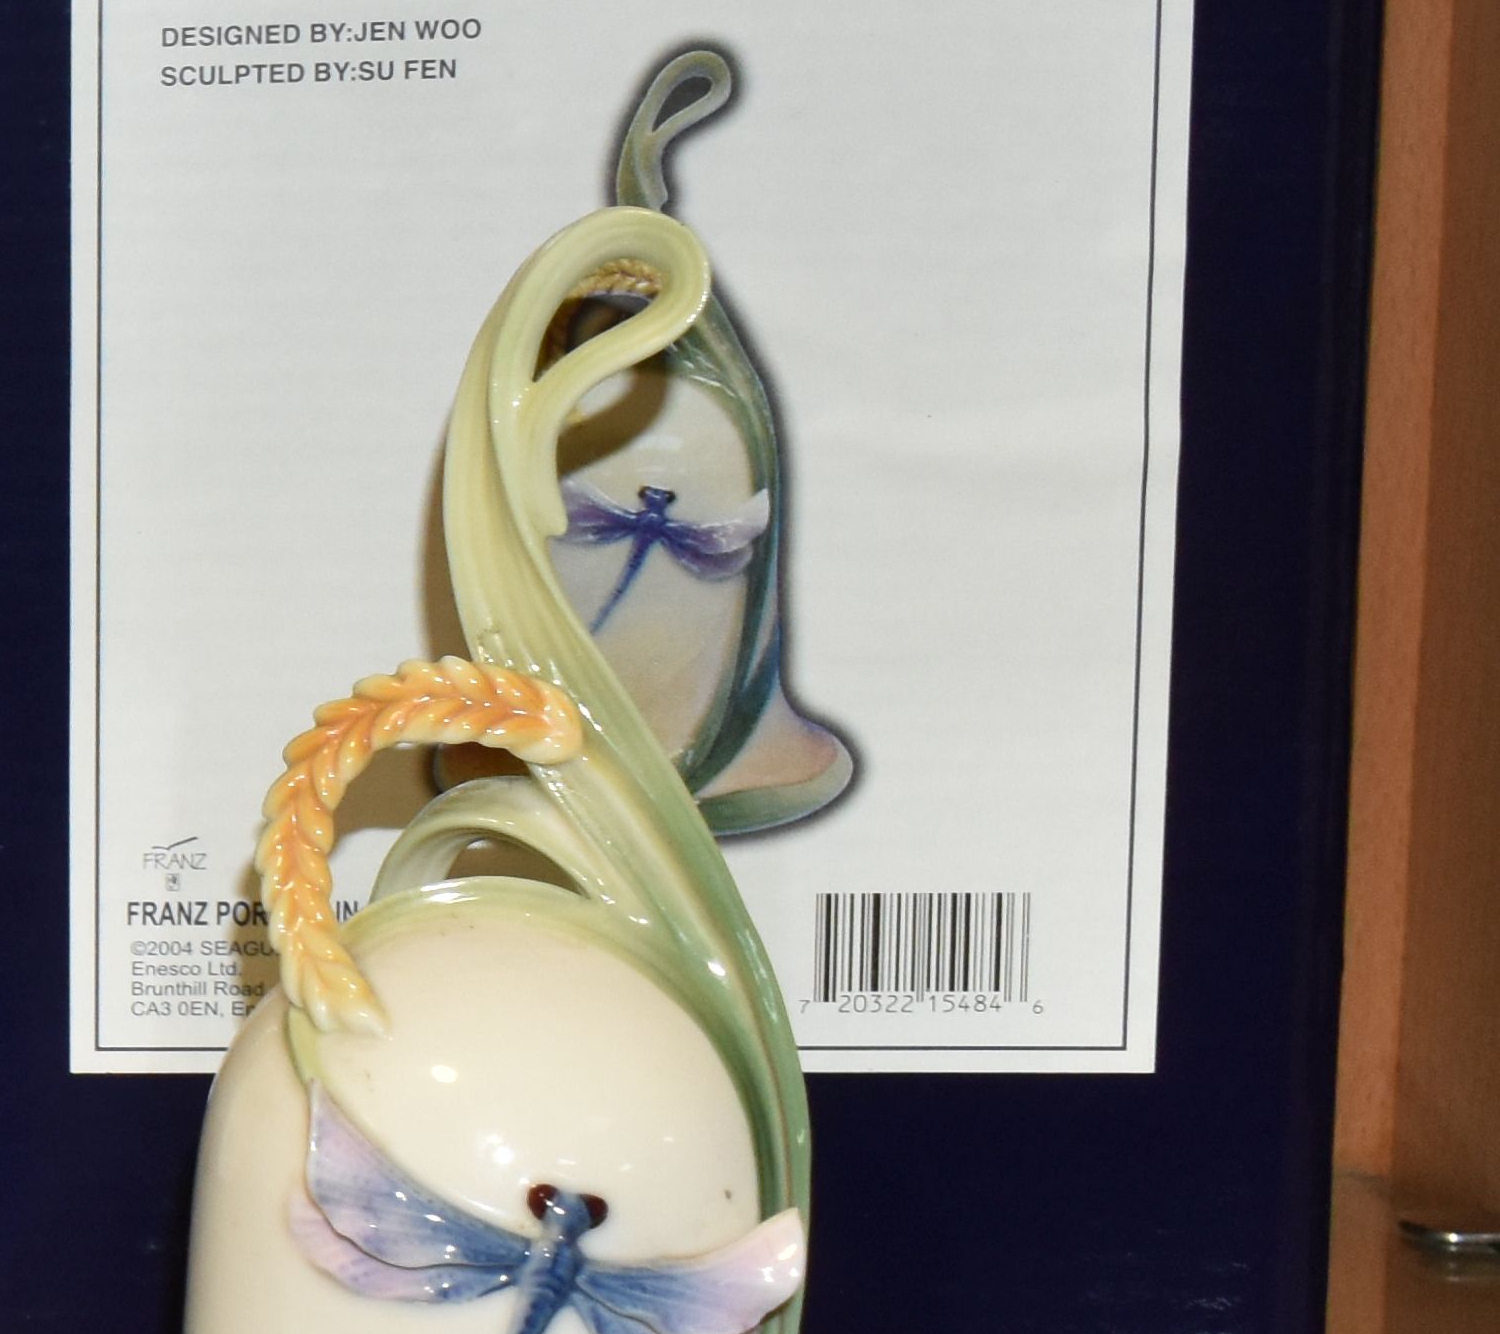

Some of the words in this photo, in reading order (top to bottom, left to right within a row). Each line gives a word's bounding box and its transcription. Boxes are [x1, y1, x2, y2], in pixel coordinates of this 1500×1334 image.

[161, 23, 300, 47] DESIGNED
[414, 18, 482, 40] WOO
[160, 63, 304, 87] SCULPTED
[404, 58, 457, 80] FEN
[143, 852, 207, 870] FRANZ
[127, 901, 208, 926] FRANZ
[200, 940, 279, 957] SEAGU
[131, 961, 201, 976] Enesco
[208, 961, 243, 976] Ltd.
[131, 981, 208, 996] Brunthill
[131, 1001, 172, 1017] CA3
[837, 994, 914, 1013] 20322
[929, 994, 1002, 1013] 15484
